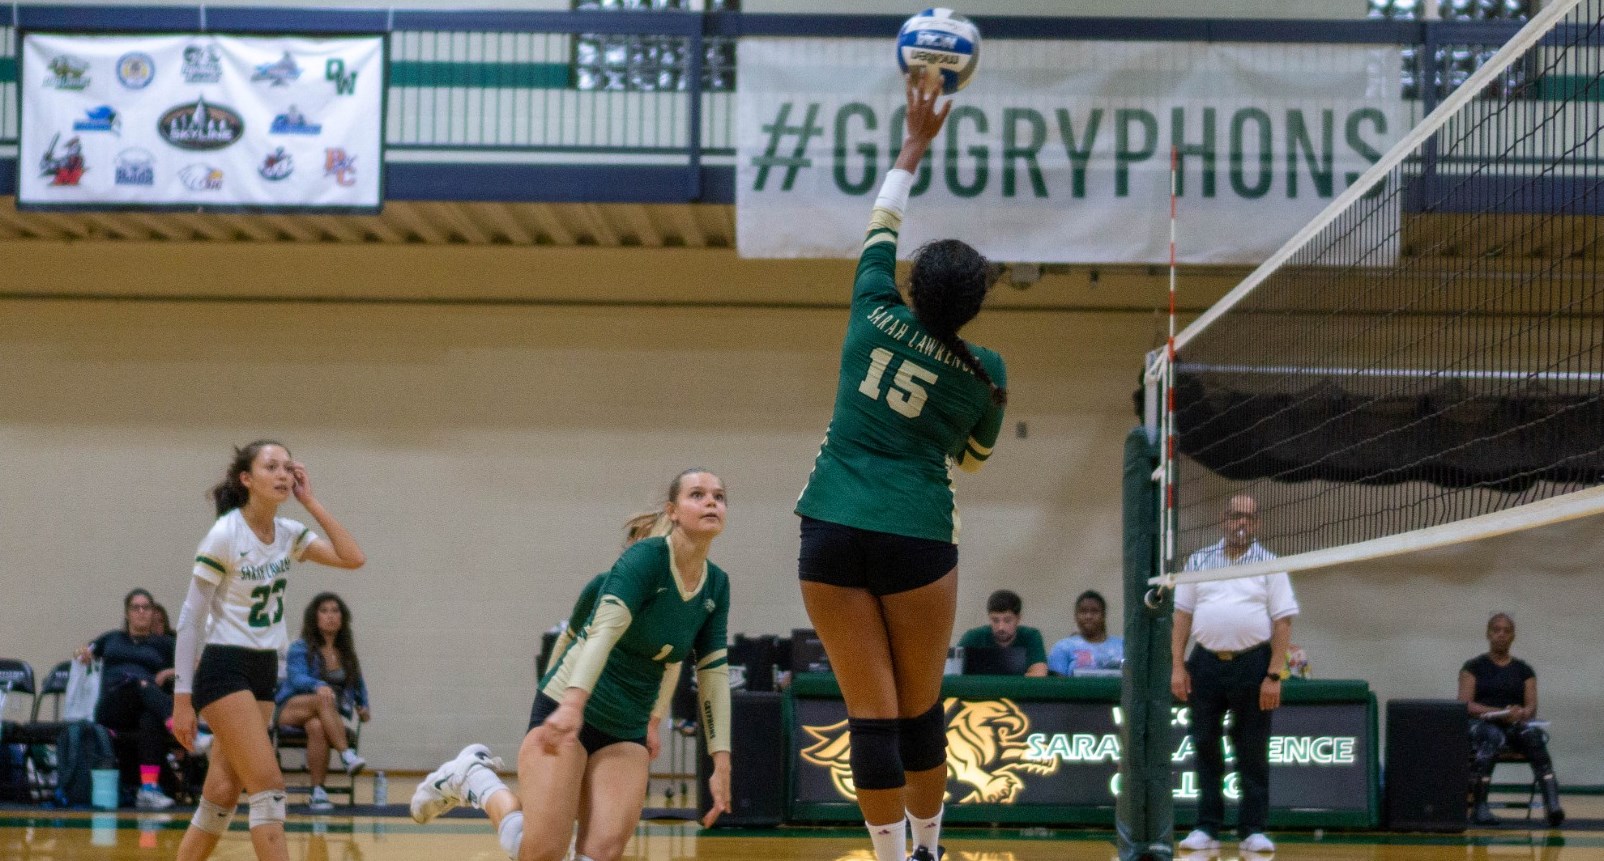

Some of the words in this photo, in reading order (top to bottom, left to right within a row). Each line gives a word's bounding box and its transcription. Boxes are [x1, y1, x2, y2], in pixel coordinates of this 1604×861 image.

[169, 129, 233, 141] SKYLINE
[751, 101, 1388, 200] #GOGRYPHONS
[866, 305, 909, 341] SARAH
[907, 330, 976, 376] LAWREN
[858, 347, 918, 419] 15
[248, 578, 287, 628] 23
[1026, 733, 1121, 761] SARA
